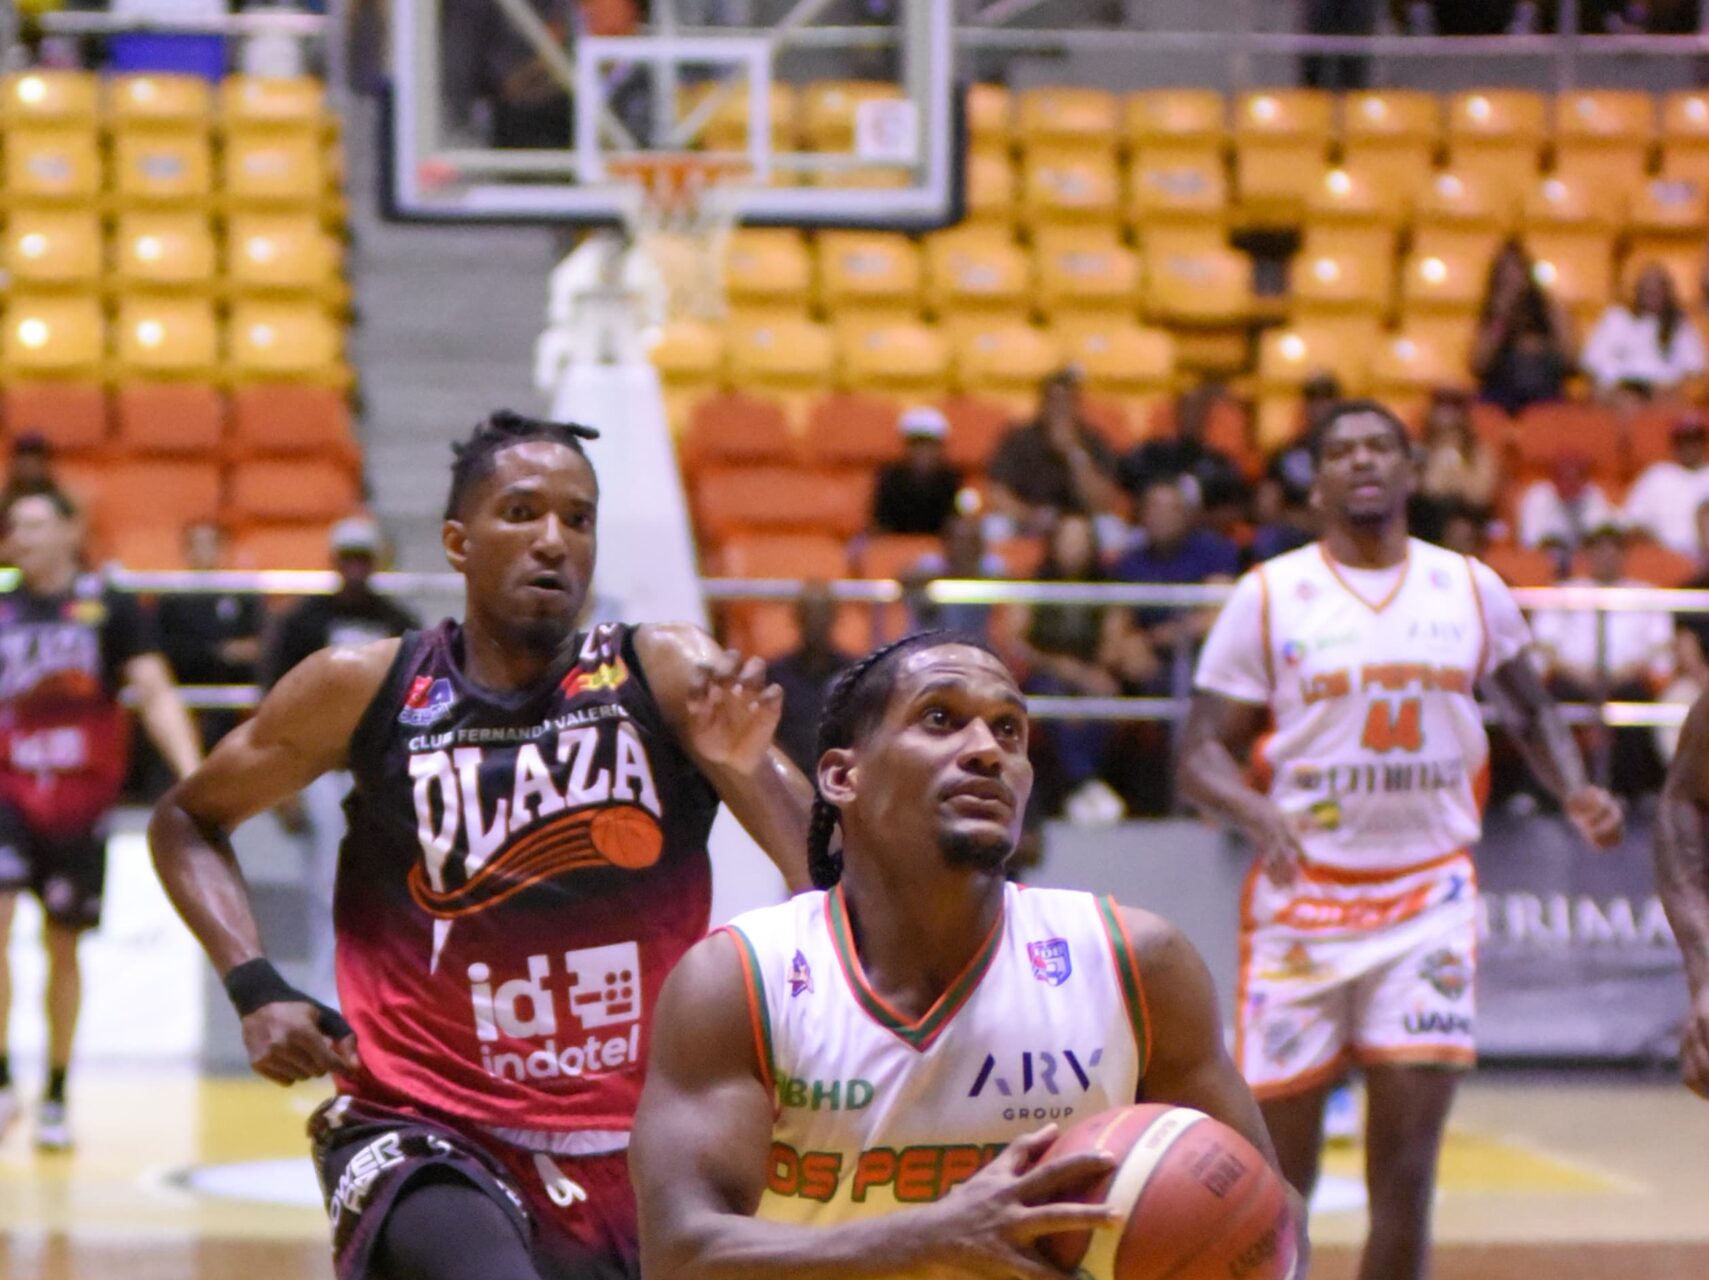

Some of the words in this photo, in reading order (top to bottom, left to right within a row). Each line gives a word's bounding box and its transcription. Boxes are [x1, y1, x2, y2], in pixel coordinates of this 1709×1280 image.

[1360, 696, 1423, 754] 44
[407, 722, 664, 975] PLAZA
[467, 954, 557, 1041] id
[479, 1023, 641, 1081] indotel
[967, 1048, 1104, 1098] ARV
[782, 1078, 875, 1112] BHD
[1002, 1106, 1075, 1121] GROUP
[767, 1141, 844, 1204] OS
